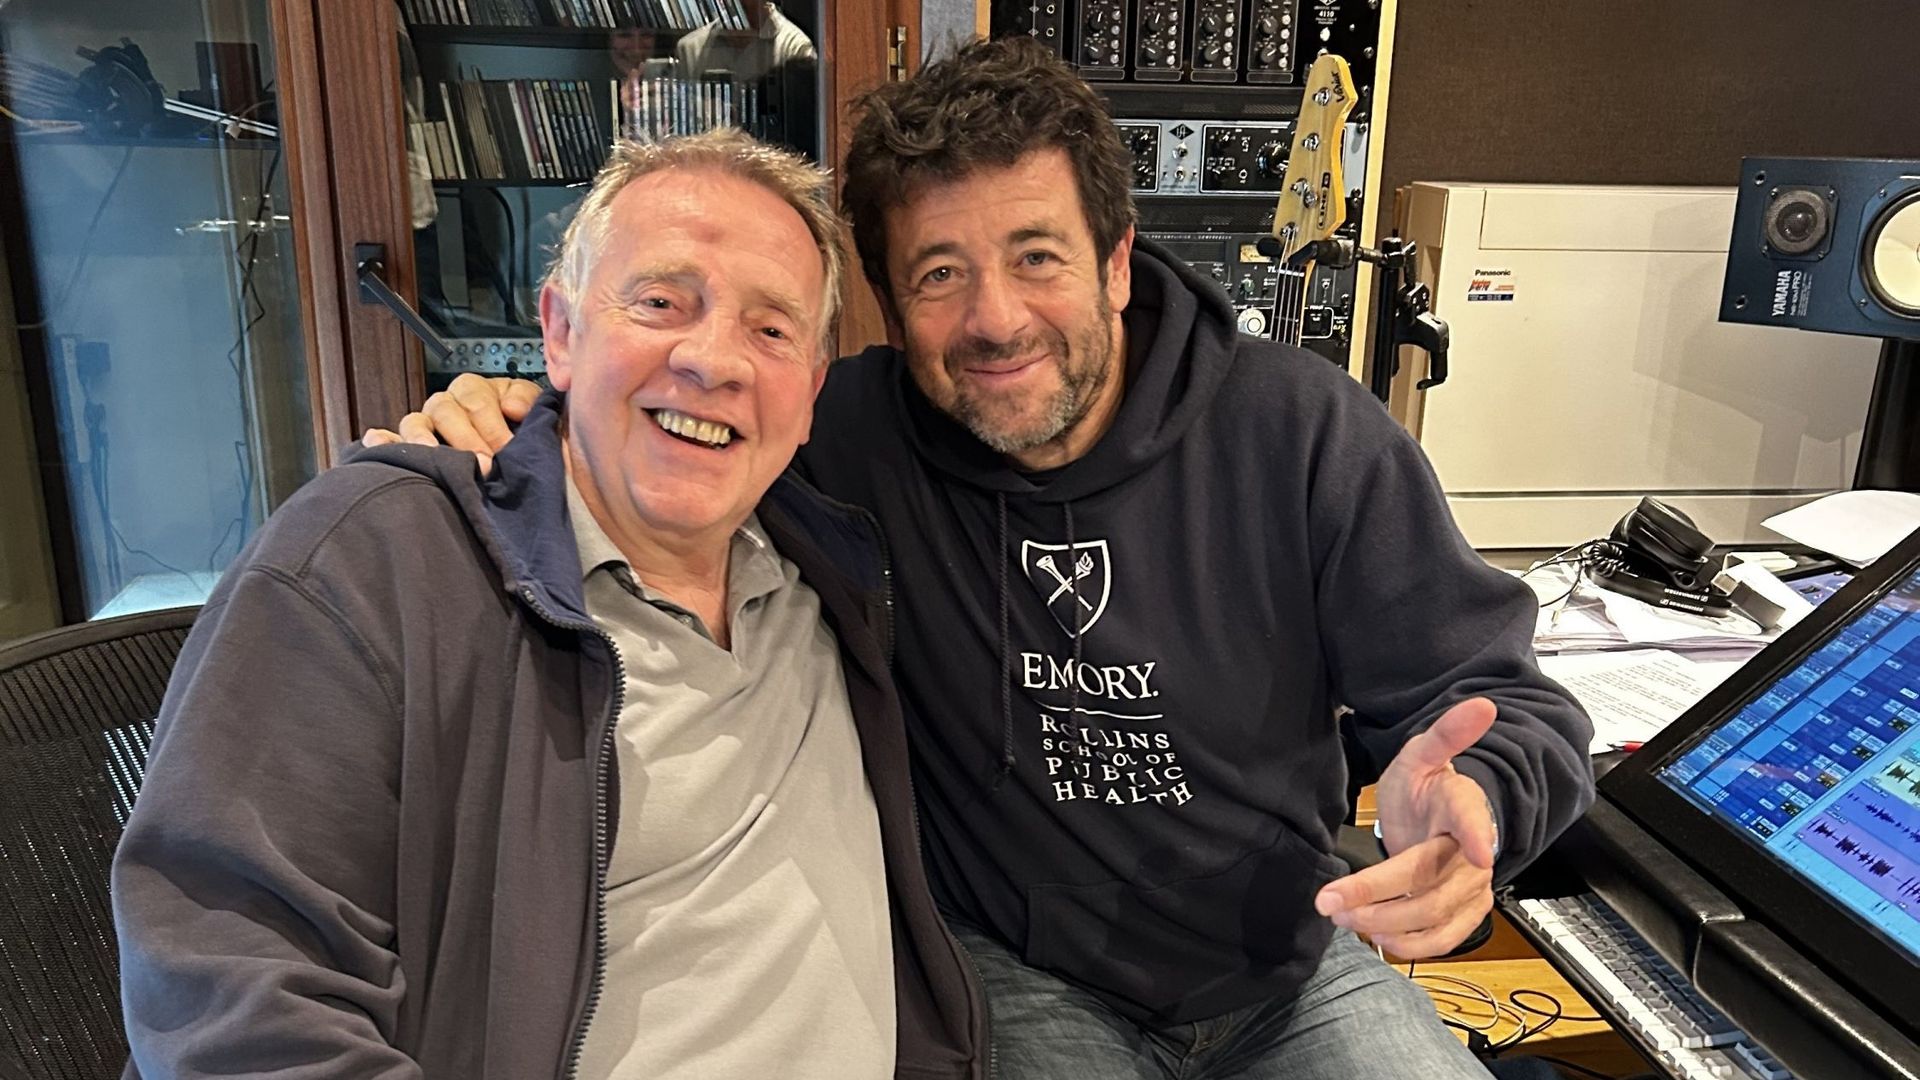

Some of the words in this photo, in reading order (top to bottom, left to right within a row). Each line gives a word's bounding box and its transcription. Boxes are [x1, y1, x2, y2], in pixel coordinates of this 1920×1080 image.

[1771, 270, 1792, 316] YAMAHA
[1145, 752, 1176, 765] OF
[1052, 781, 1194, 806] HEALTH
